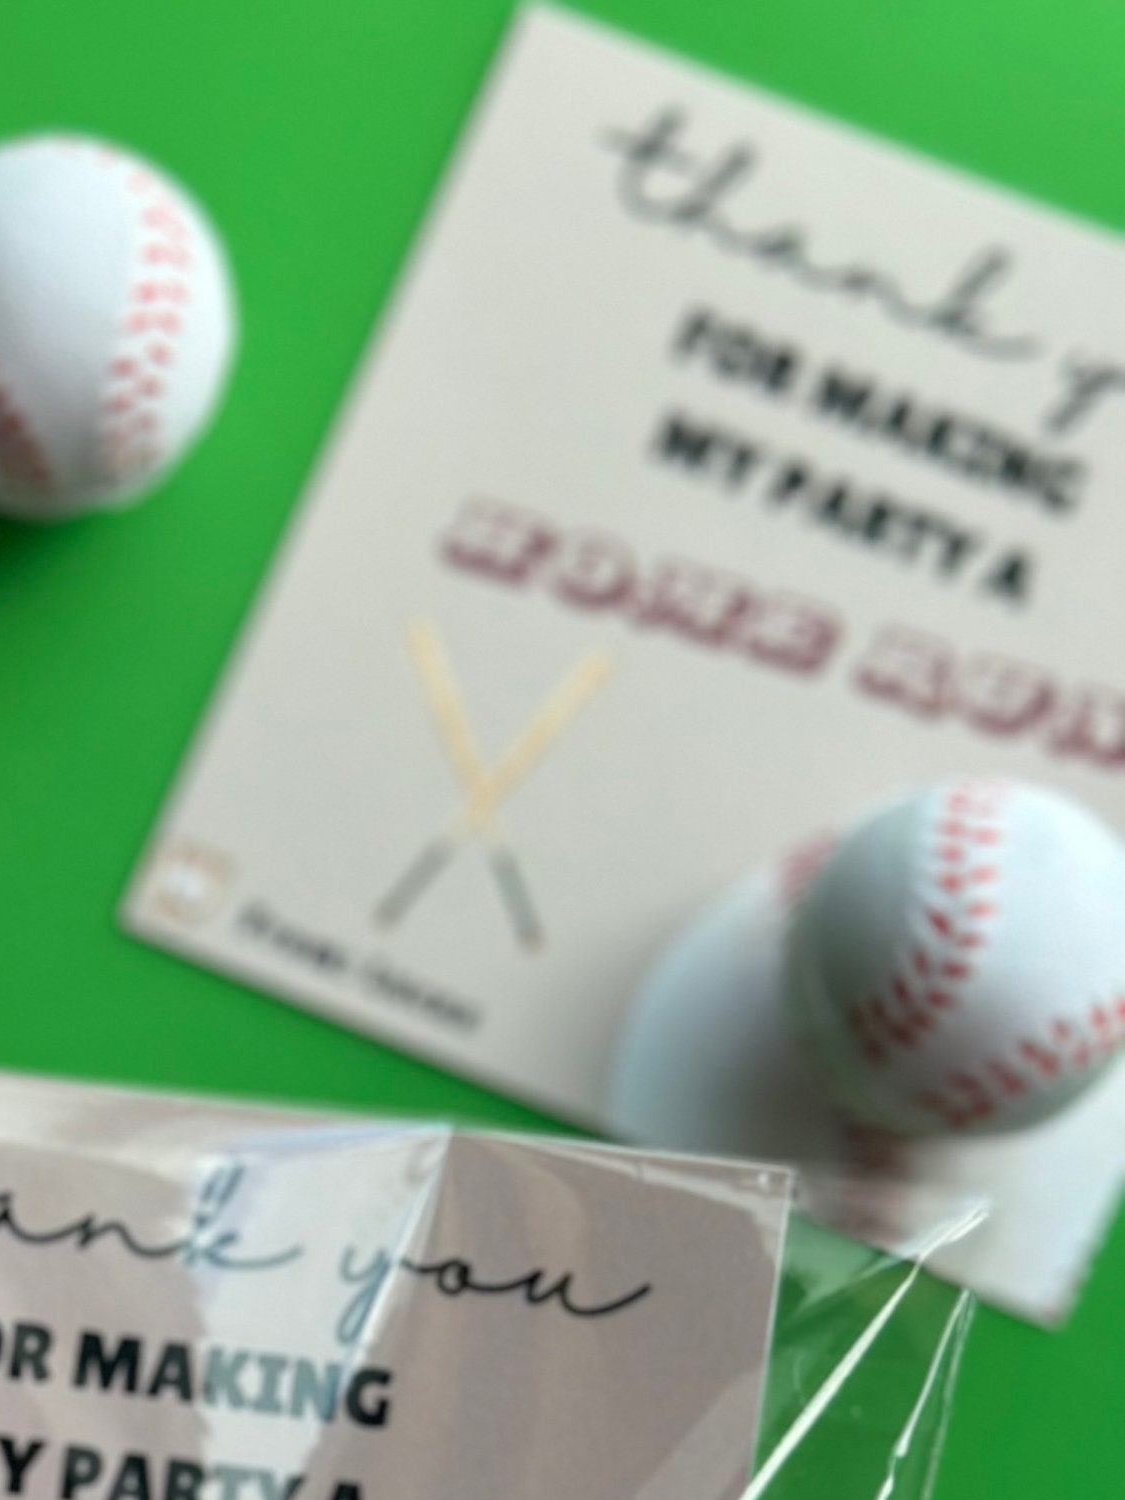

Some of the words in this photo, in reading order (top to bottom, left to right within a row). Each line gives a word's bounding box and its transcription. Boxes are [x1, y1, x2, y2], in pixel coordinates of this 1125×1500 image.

[673, 302, 797, 400] FOR
[812, 361, 1089, 518] MAKING
[648, 408, 753, 496] MY
[767, 455, 983, 582] PARTY
[987, 546, 1037, 610] A
[340, 1238, 651, 1346] you
[72, 1330, 395, 1430] MAKING
